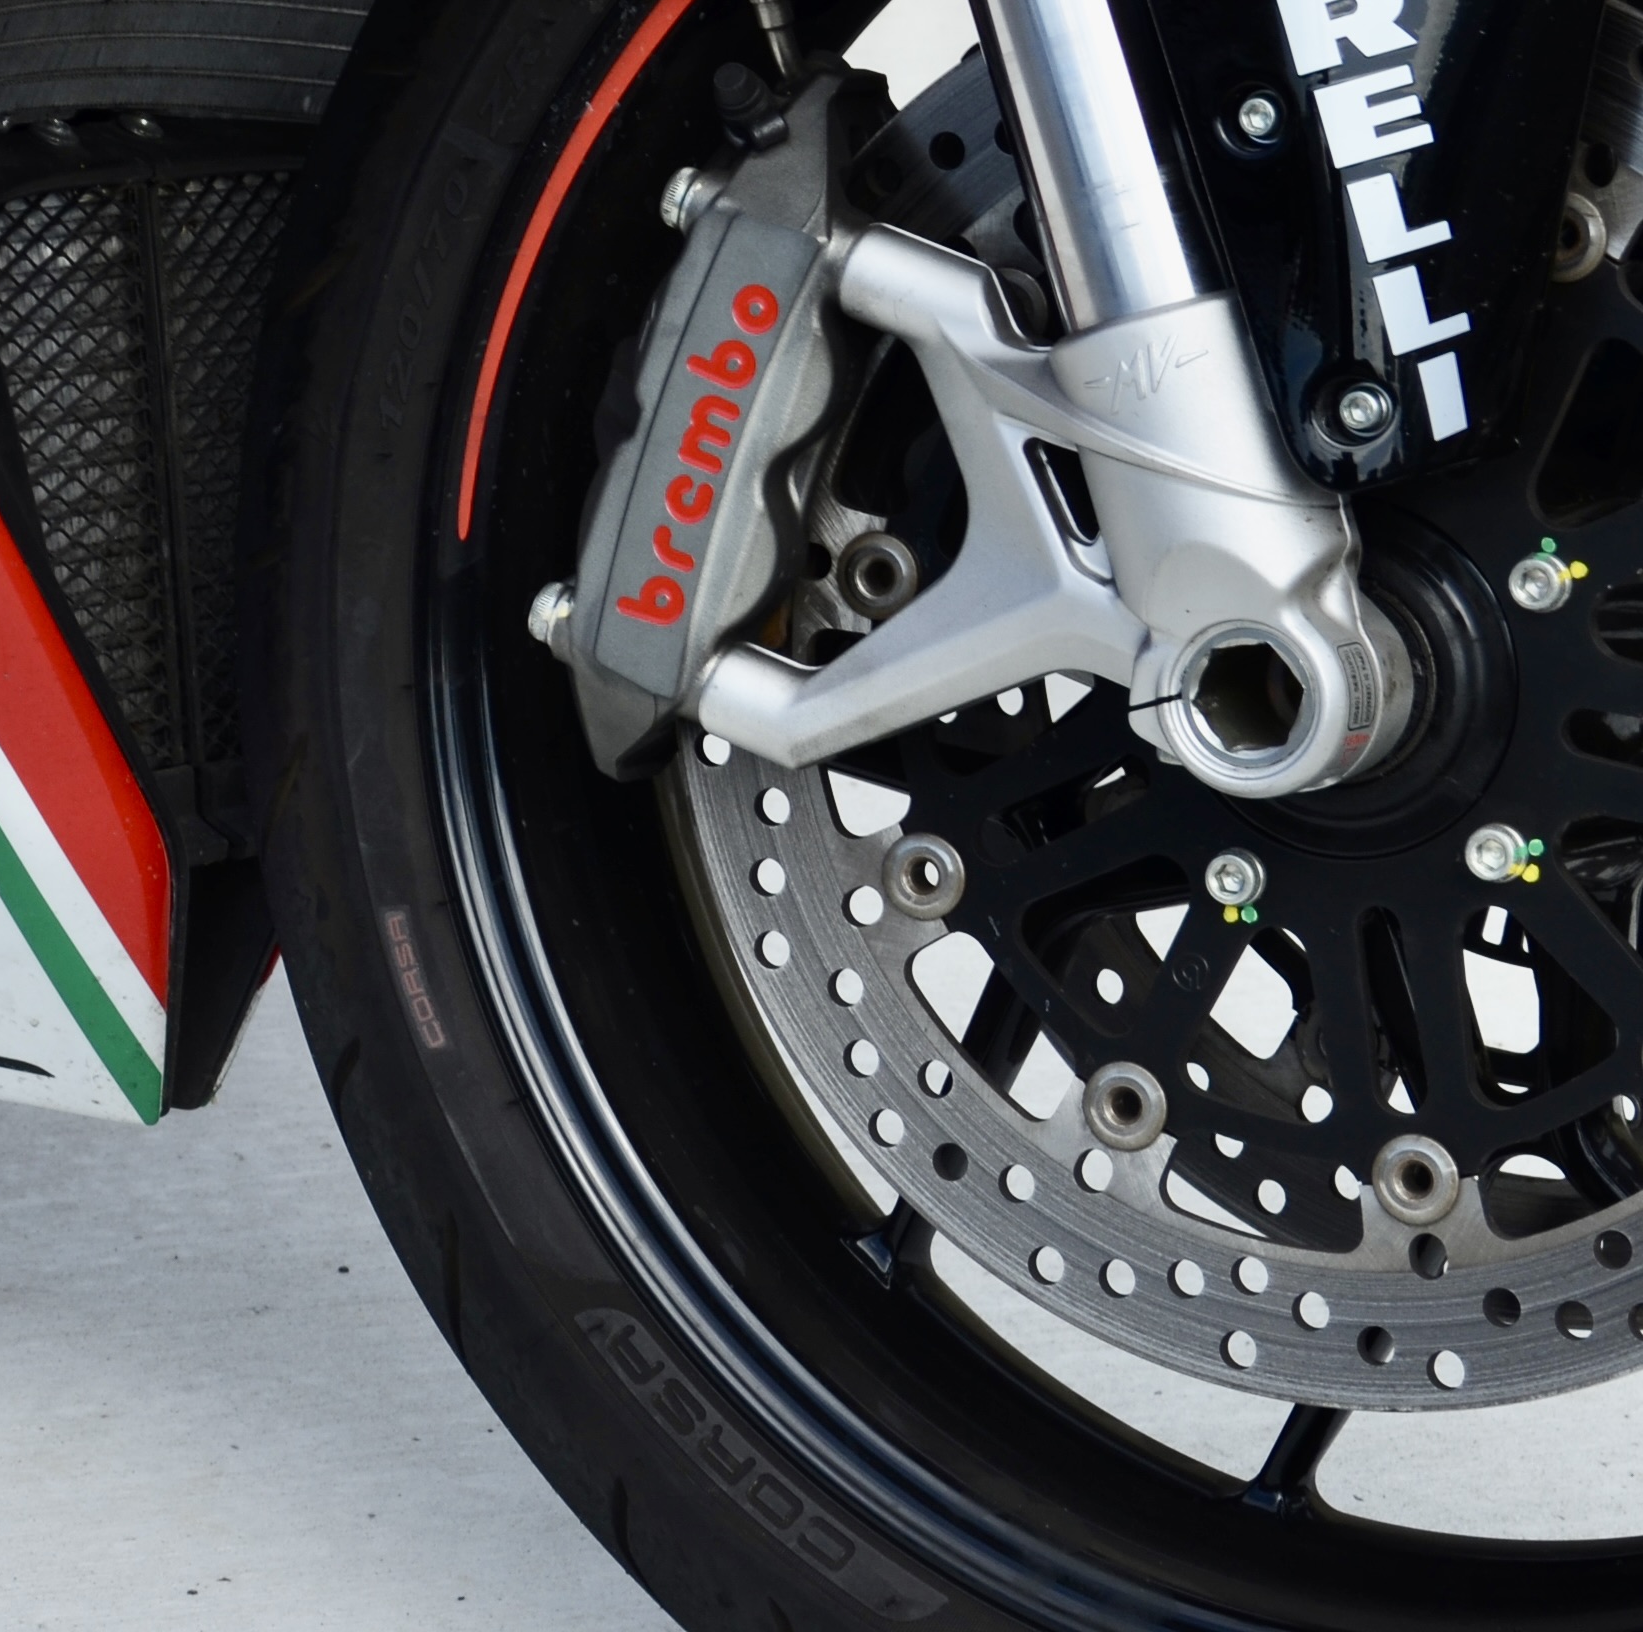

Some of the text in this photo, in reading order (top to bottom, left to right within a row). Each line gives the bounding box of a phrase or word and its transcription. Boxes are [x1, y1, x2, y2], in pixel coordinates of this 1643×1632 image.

[615, 283, 779, 627] brembo
[385, 909, 446, 1050] CORSA
[605, 1324, 858, 1572] CORSA
